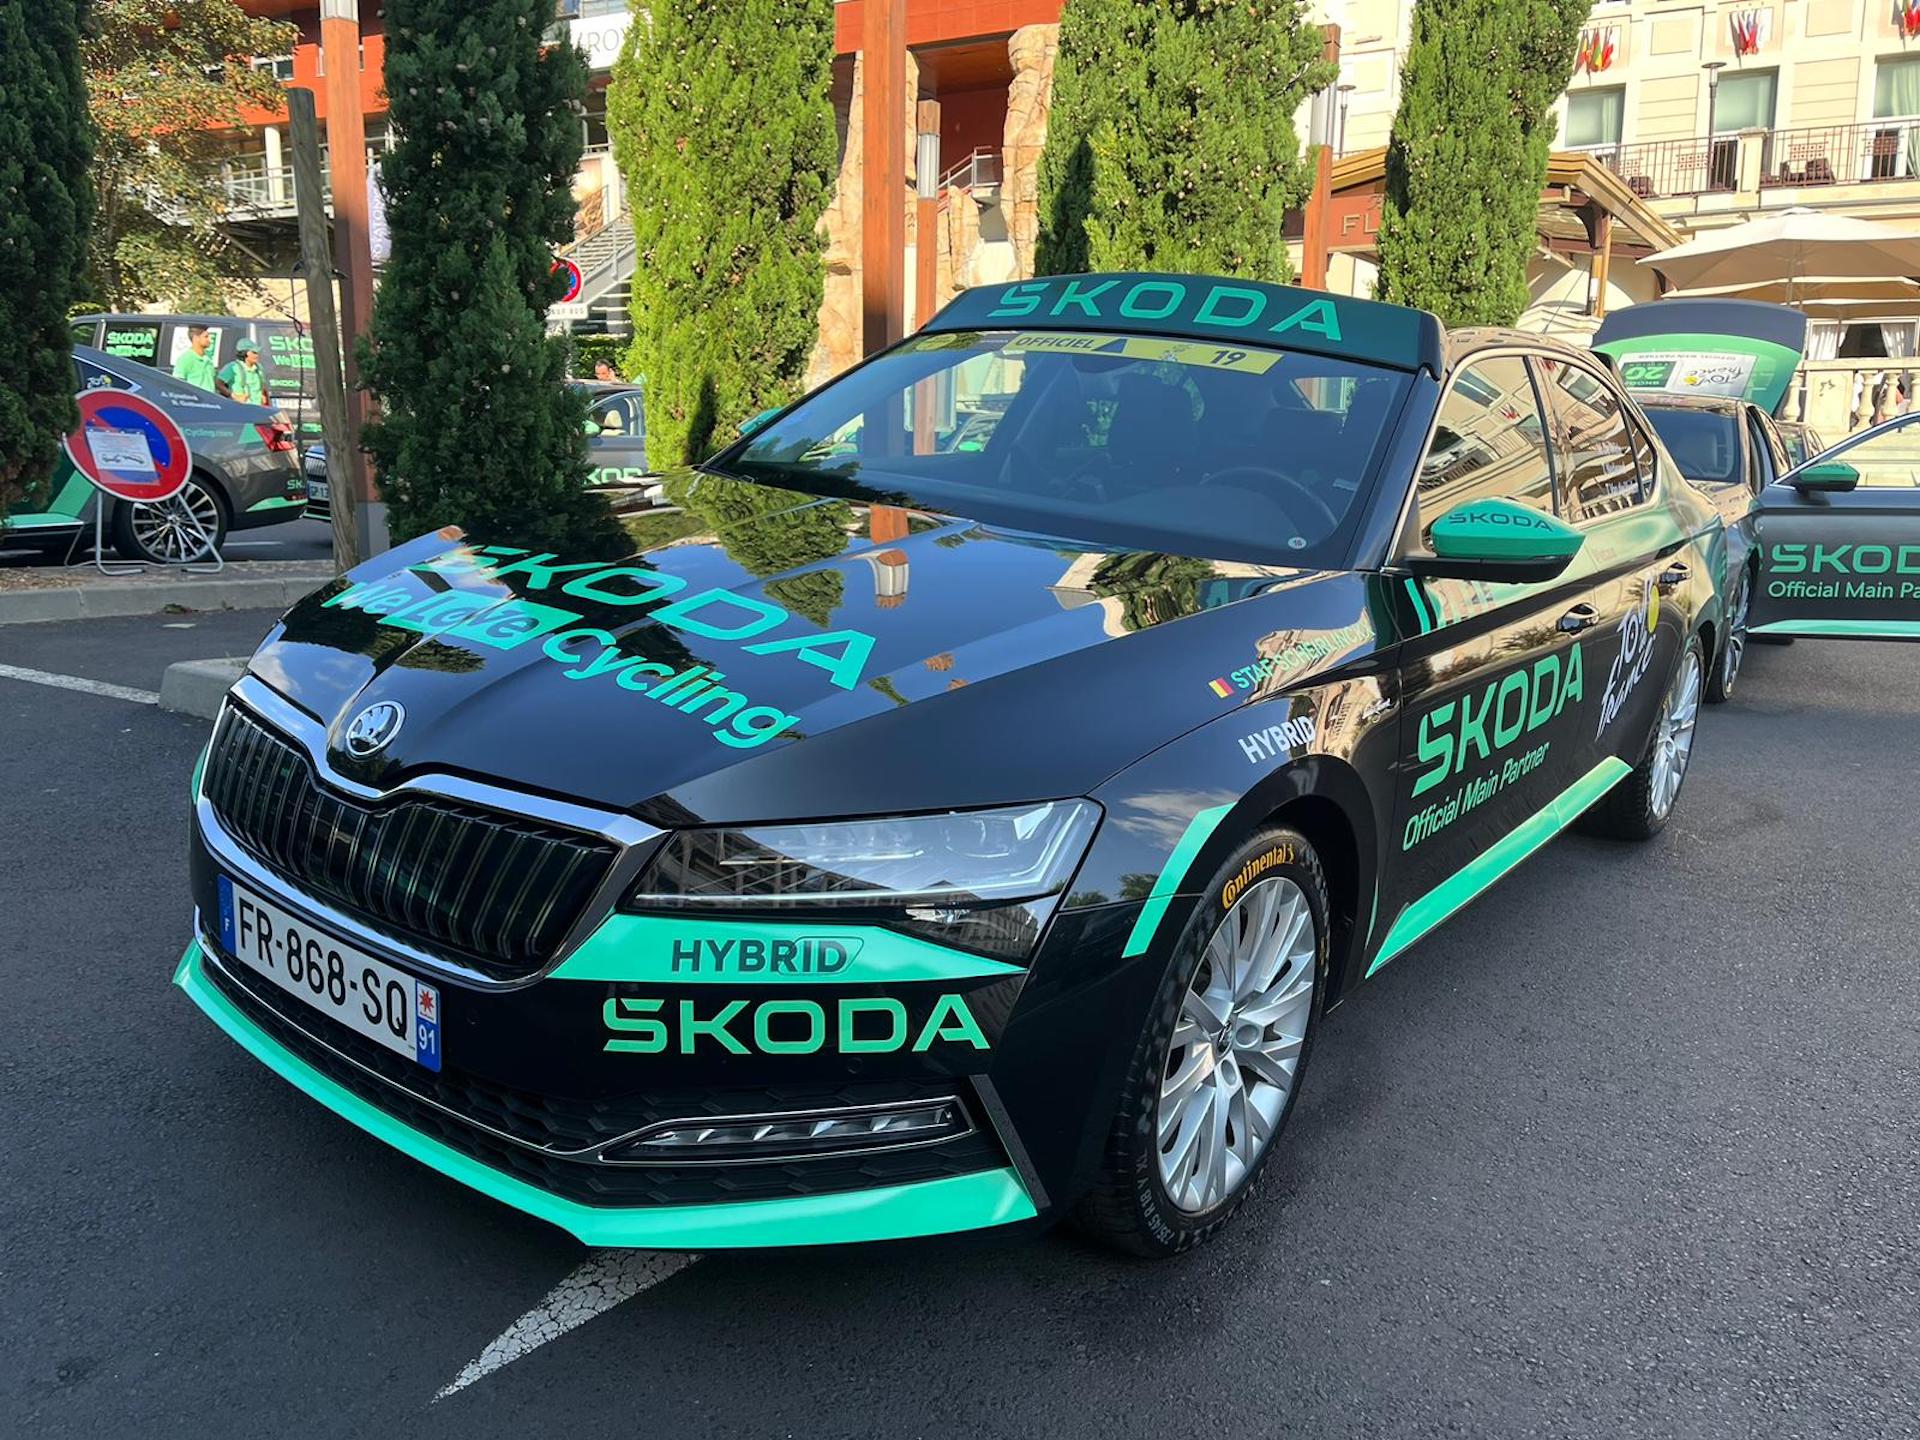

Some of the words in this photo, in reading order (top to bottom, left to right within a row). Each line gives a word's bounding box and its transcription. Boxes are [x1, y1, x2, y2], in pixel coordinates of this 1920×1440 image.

[1015, 335, 1095, 350] OFFICIEL
[1211, 349, 1247, 366] 19
[1768, 580, 1840, 598] Official
[1845, 581, 1893, 598] Main
[541, 629, 801, 749] Cycling
[1238, 714, 1317, 764] HYBRID
[1403, 790, 1463, 851] Official
[1460, 768, 1499, 815] Main
[1500, 741, 1550, 792] Partner
[1222, 843, 1287, 909] Continental
[239, 897, 408, 1041] FR-868-SQ
[671, 939, 849, 974] HYBRID
[419, 1023, 437, 1055] 91
